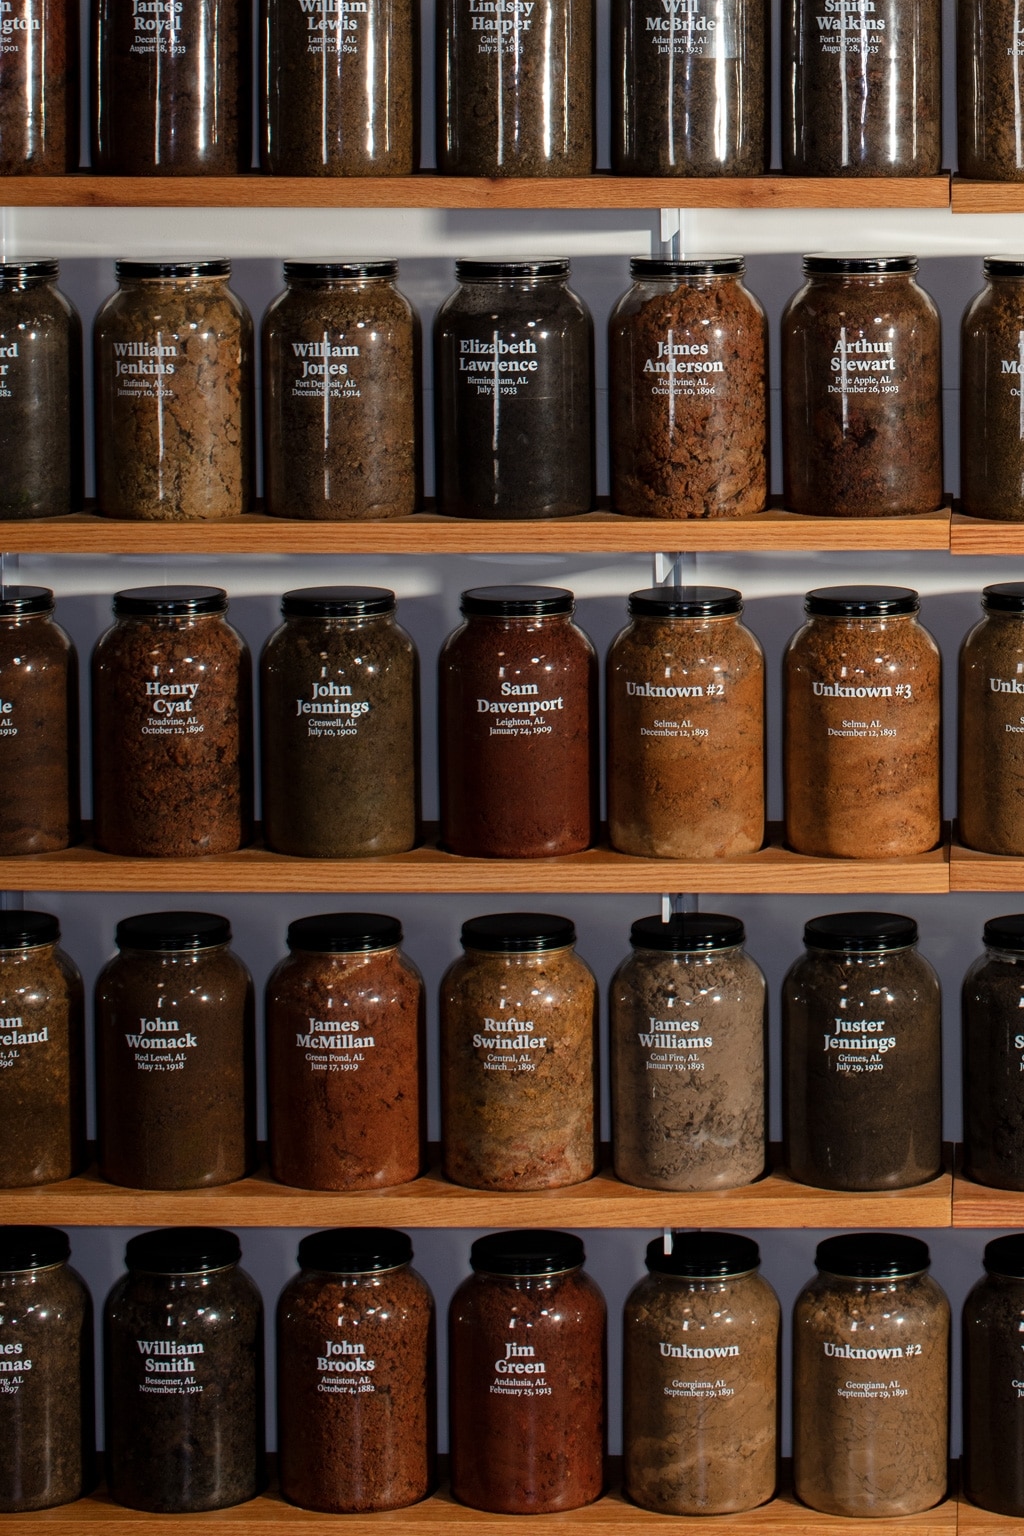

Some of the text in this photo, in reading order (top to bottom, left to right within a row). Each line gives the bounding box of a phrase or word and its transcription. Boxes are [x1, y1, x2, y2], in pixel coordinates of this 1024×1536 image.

[307, 16, 357, 30] Lewis
[292, 342, 359, 357] William
[833, 338, 892, 353] Arthur
[302, 361, 348, 378] Jones
[830, 357, 896, 371] Stewart
[145, 682, 199, 698] Henry
[153, 699, 192, 717] Cyat
[147, 716, 198, 726] Toadvine, AL
[141, 724, 204, 735] October 12, 1896
[140, 1017, 179, 1034] John
[125, 1033, 197, 1048] Womack
[135, 1053, 187, 1062] Red Level, AL
[138, 1062, 153, 1072] May
[166, 1062, 184, 1071] 1918
[137, 1341, 204, 1355] William
[145, 1358, 195, 1372] Smith
[145, 1376, 196, 1386] Bessemer, AL
[139, 1385, 177, 1394] November
[186, 1385, 203, 1394] 1912
